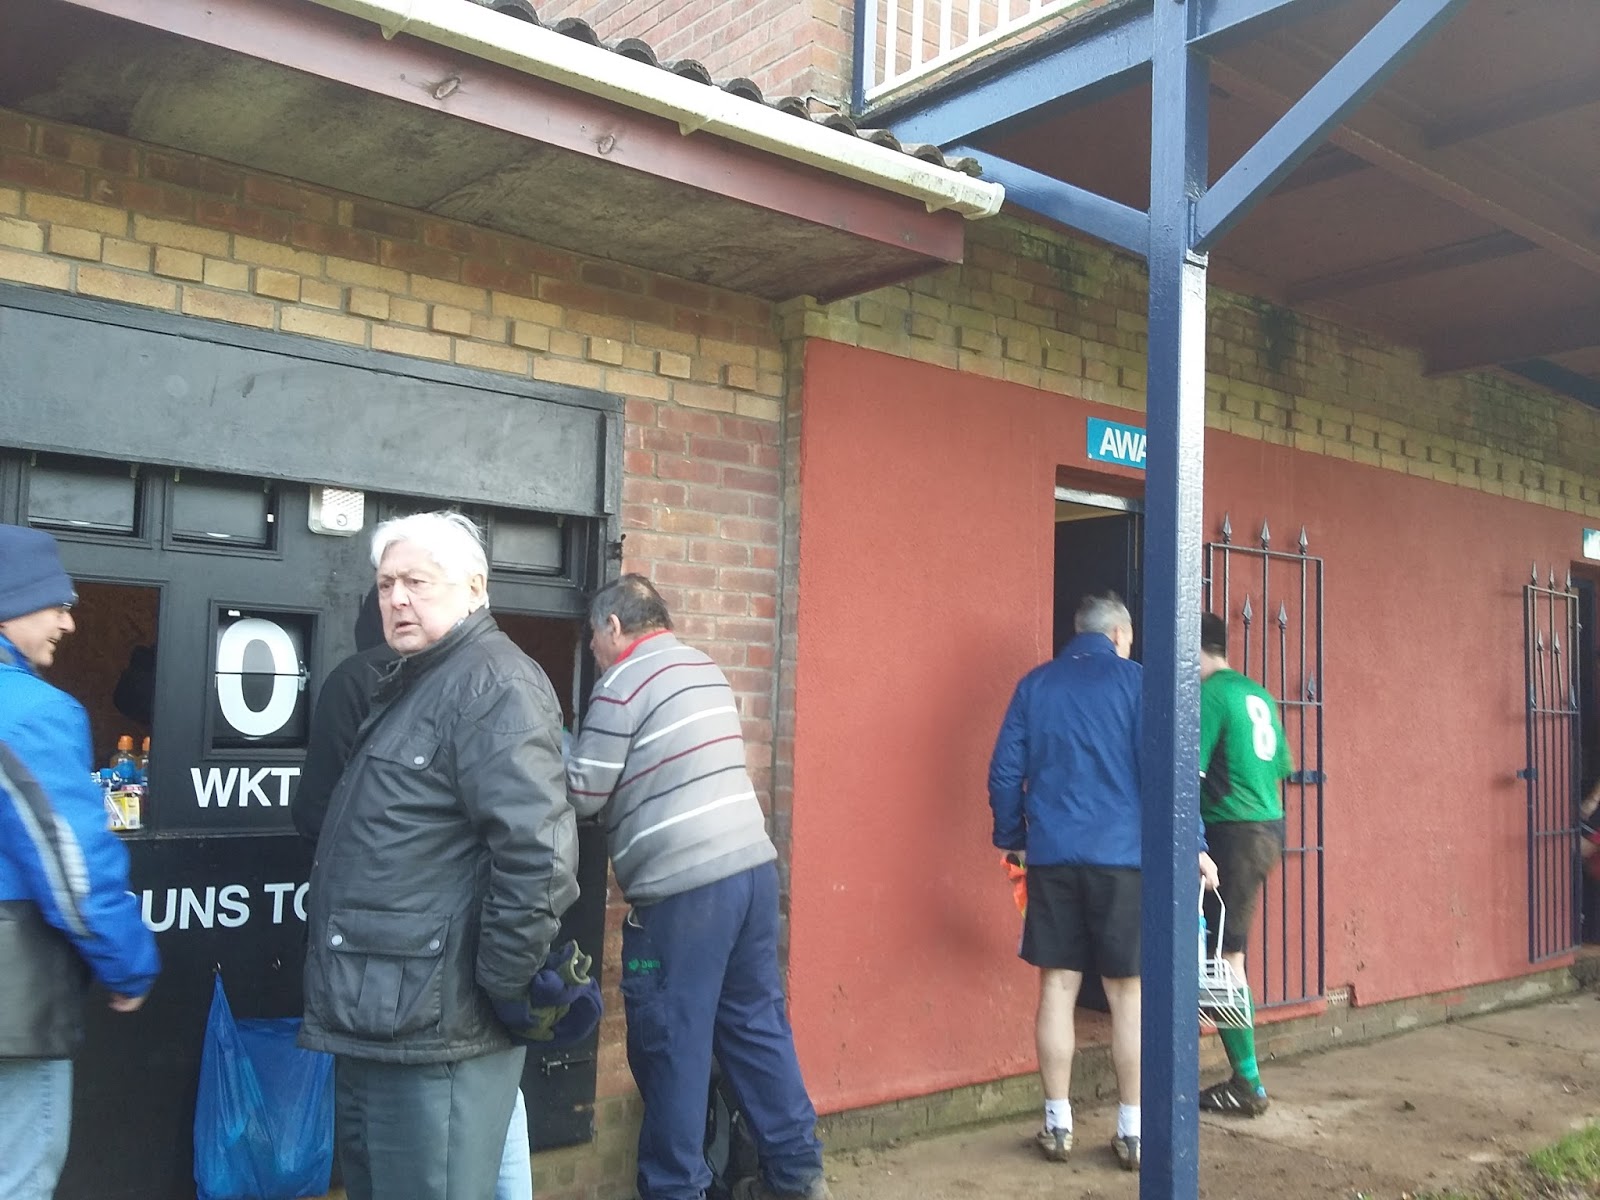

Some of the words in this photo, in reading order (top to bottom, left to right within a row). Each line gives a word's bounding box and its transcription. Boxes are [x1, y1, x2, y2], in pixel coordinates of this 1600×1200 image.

[217, 618, 299, 736] 0
[1245, 694, 1278, 762] 8
[190, 768, 301, 808] WKT
[123, 884, 251, 933] UNS
